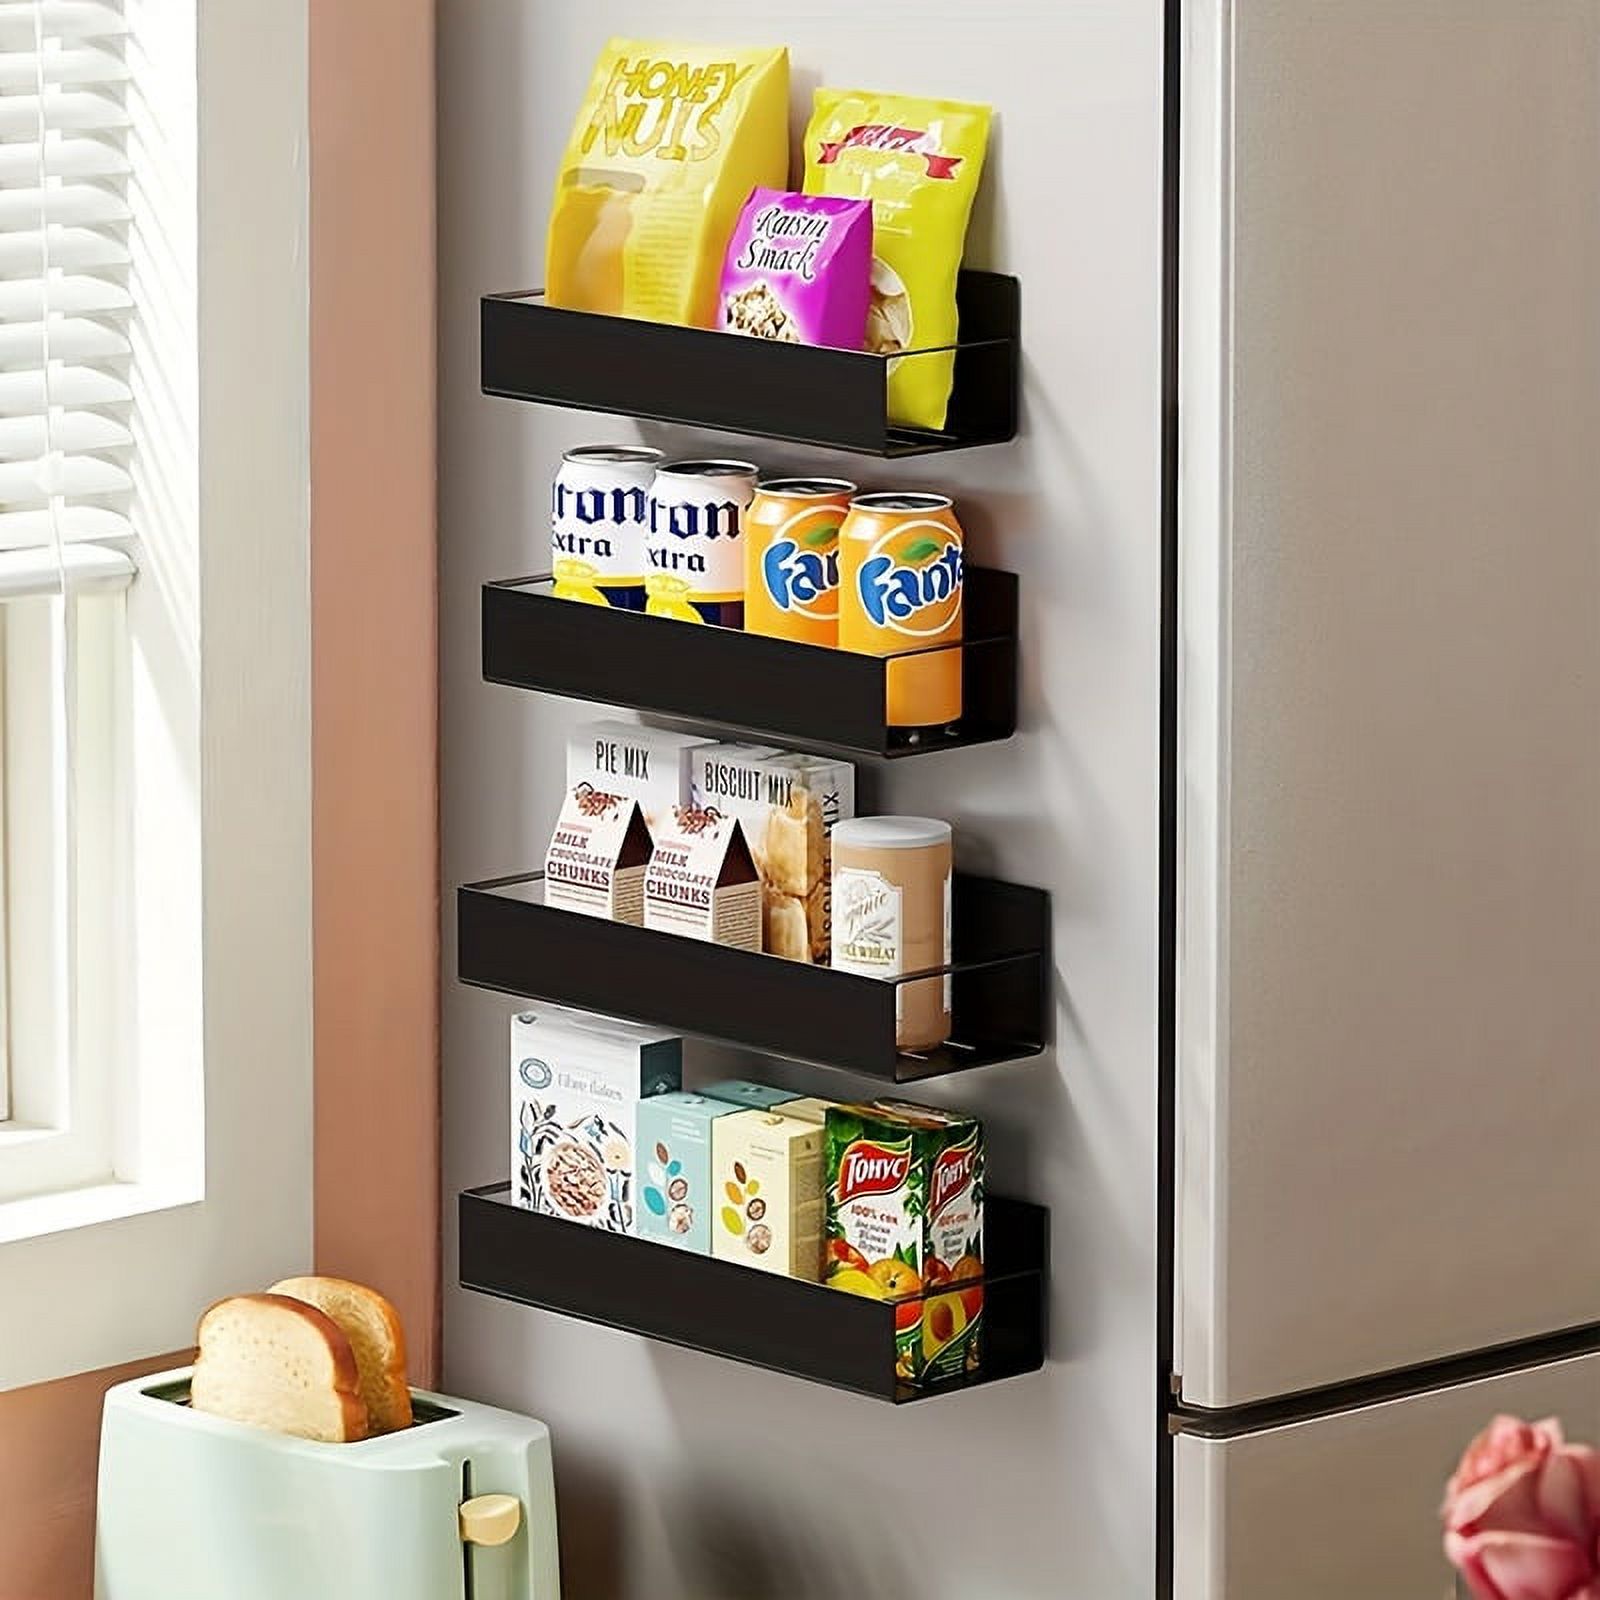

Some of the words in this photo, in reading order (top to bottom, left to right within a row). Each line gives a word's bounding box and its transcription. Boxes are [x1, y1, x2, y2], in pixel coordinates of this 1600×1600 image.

[605, 57, 755, 103] HONEY
[757, 207, 828, 240] Raisin
[737, 239, 820, 281] Smack
[552, 482, 645, 525] ron
[552, 530, 612, 557] xtra
[595, 740, 617, 775] PIE
[624, 746, 650, 781] MIX
[705, 761, 760, 801] BISCUIT
[768, 773, 793, 809] MIX
[554, 831, 589, 849] MILK
[654, 849, 688, 867] MILK
[547, 860, 610, 887] CHUNKS
[649, 865, 714, 887] CHOCOLATE
[646, 879, 710, 905] CHUNKS
